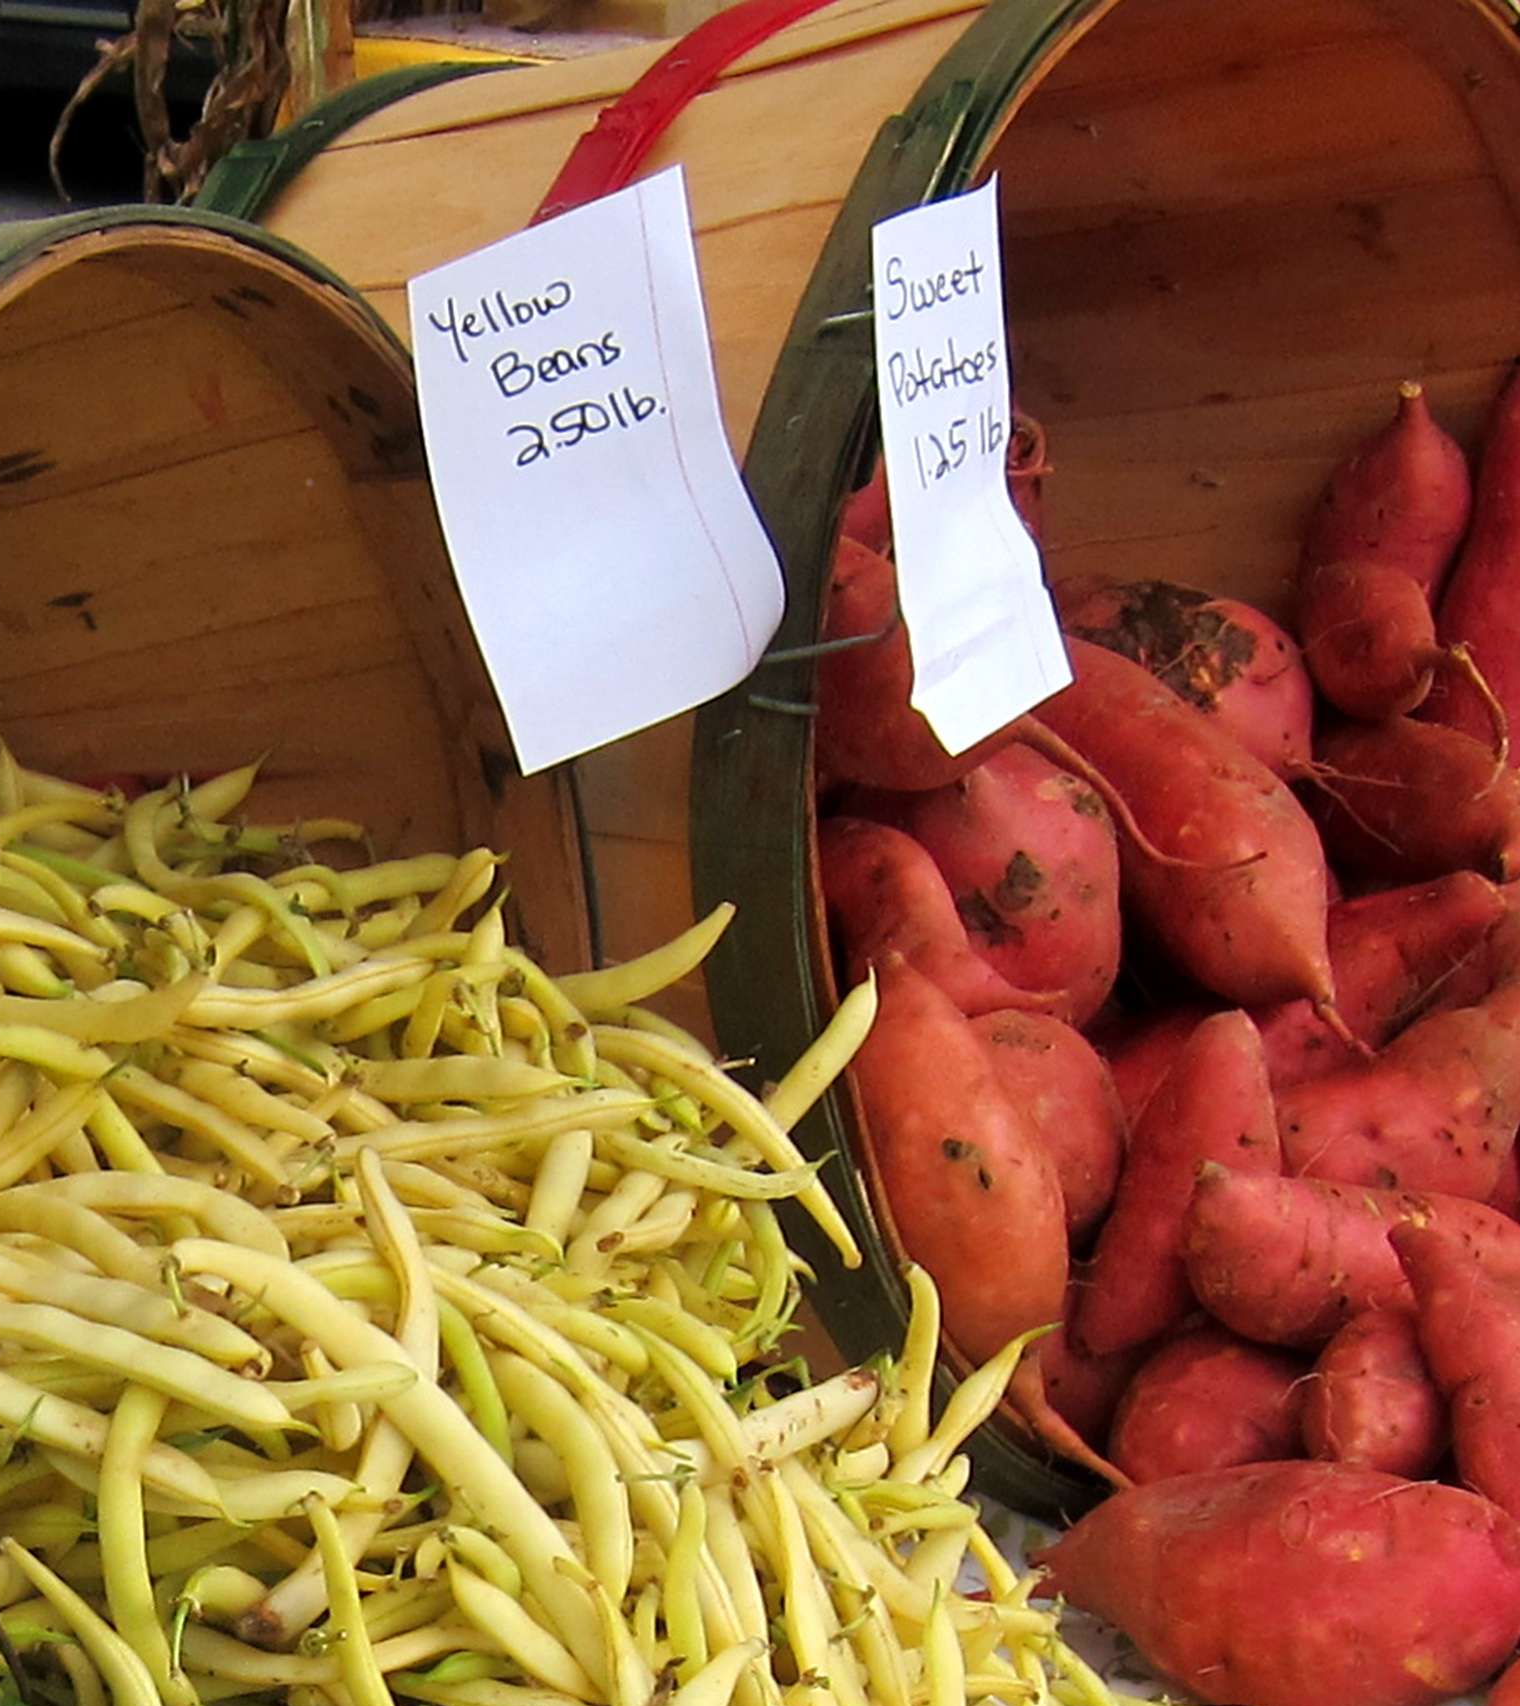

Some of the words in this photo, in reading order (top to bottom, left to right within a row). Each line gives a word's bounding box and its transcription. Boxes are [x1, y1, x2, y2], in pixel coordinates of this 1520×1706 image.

[886, 250, 984, 320] Sweet
[428, 281, 572, 363] Yellow
[490, 331, 621, 398] Beans
[888, 338, 998, 408] Potatoes
[913, 419, 968, 489] 1.25
